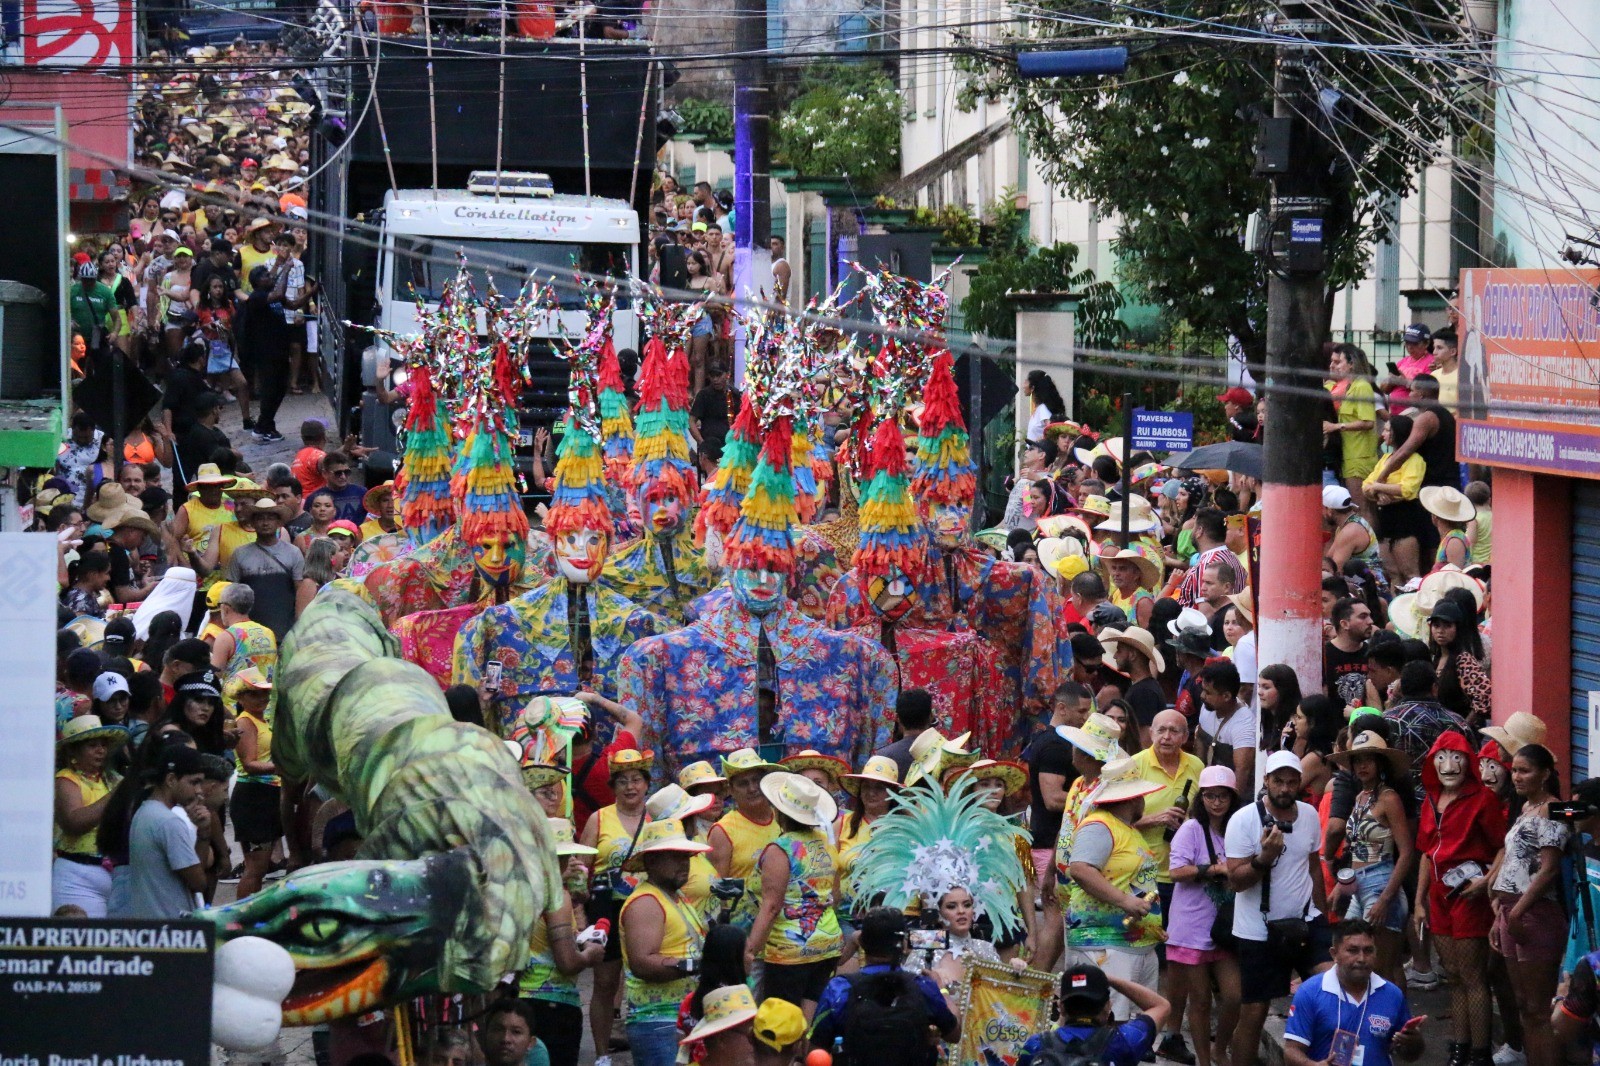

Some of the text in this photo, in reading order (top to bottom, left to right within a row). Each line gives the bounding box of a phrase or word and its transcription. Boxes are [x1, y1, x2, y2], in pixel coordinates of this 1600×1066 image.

[454, 205, 577, 224] Constellation
[1137, 415, 1173, 423] TRAVESSA
[1136, 427, 1187, 438] RUI BARBOSA
[1136, 440, 1188, 449] BAIRRO CENTRO
[31, 925, 207, 949] PREVIDENCIÁRIA
[57, 955, 154, 976] Andrade
[12, 980, 65, 994] OAB-PA
[0, 1053, 39, 1066] oria
